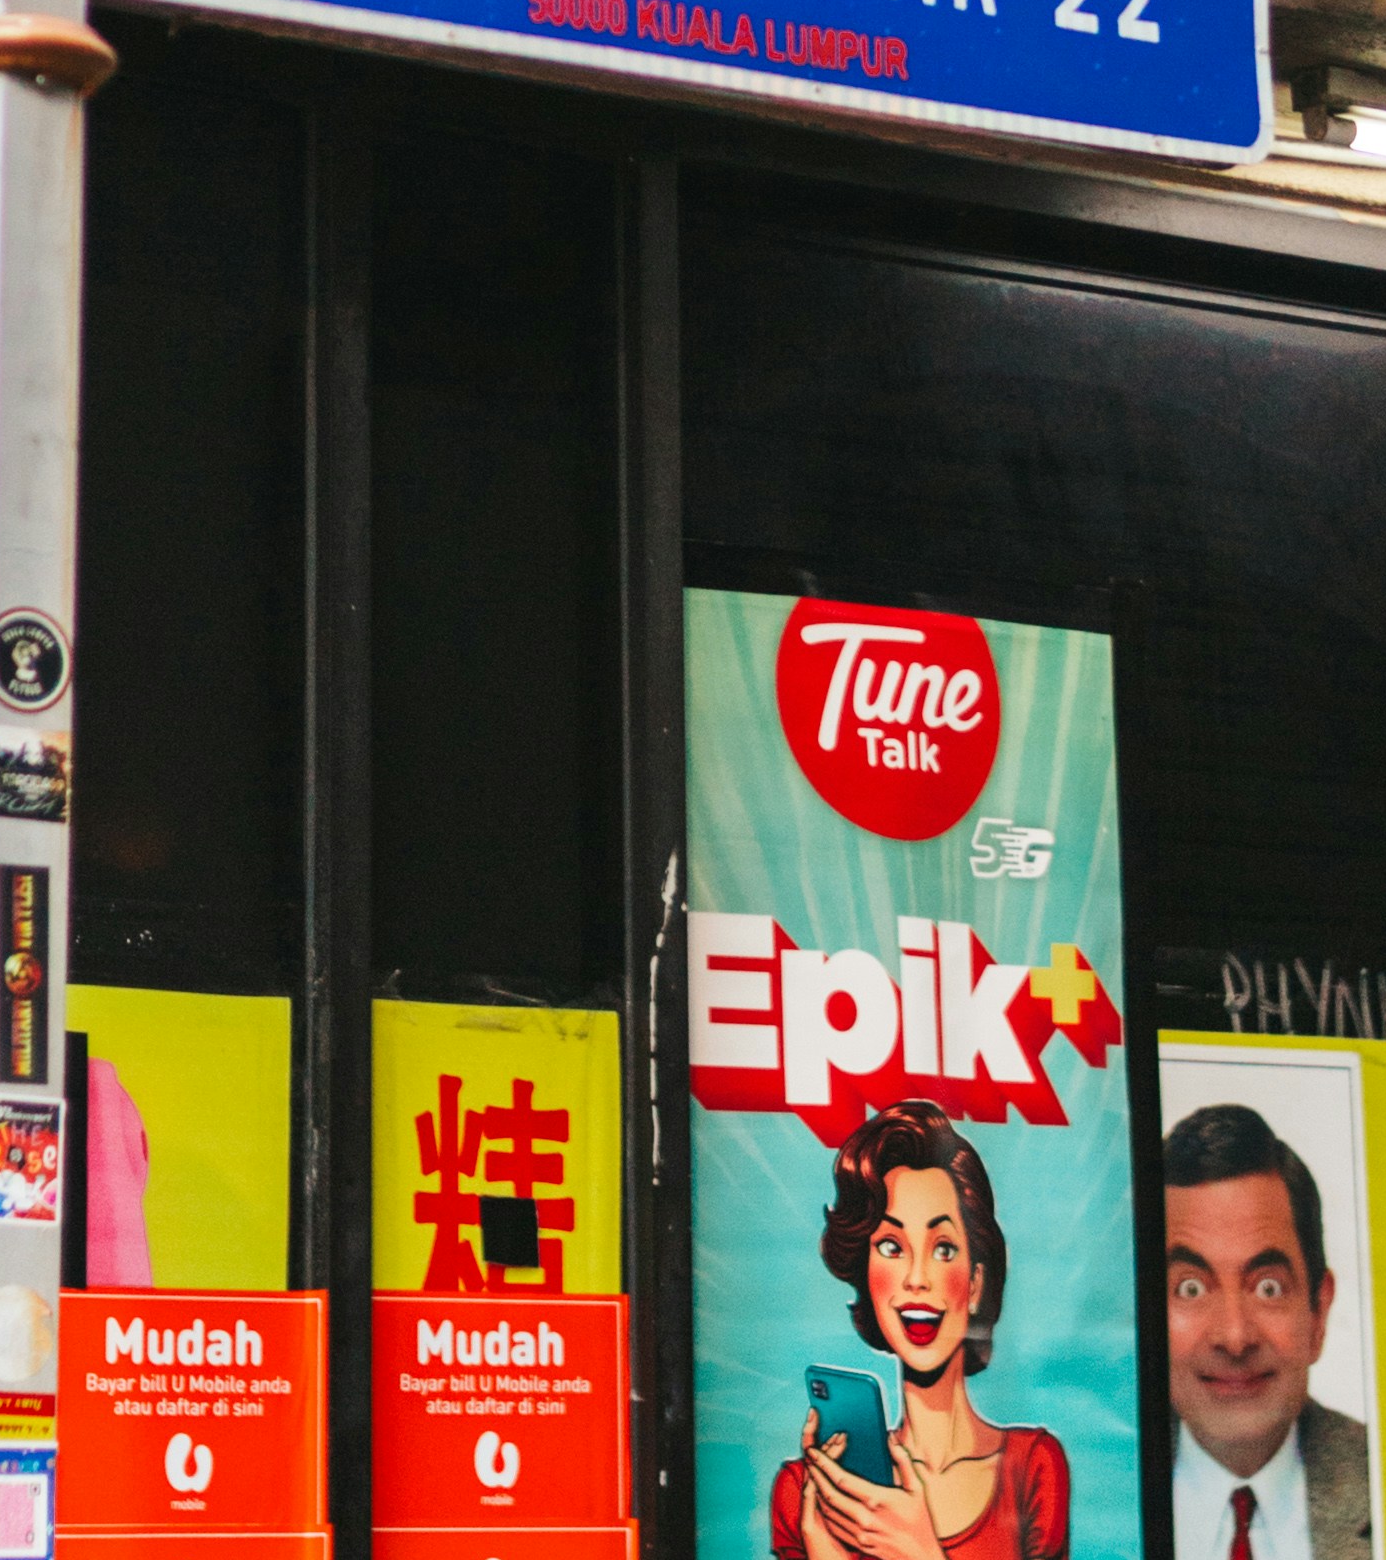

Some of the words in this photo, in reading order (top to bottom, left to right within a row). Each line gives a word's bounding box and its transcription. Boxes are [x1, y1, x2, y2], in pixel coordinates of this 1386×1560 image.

[765, 18, 909, 81] LUMPUR
[800, 622, 983, 751] Tune
[857, 727, 941, 774] Talk
[105, 1317, 262, 1367] Mudah
[416, 1318, 565, 1367] Mudah
[86, 1373, 136, 1396] Bayar
[140, 1374, 167, 1392] bill
[172, 1375, 184, 1392] U
[189, 1375, 246, 1394] Mobile
[250, 1377, 291, 1394] anda
[114, 1399, 152, 1415] atau
[156, 1398, 208, 1416] daftar
[213, 1399, 229, 1416] di
[233, 1399, 264, 1416] sini
[400, 1373, 446, 1396] Bayar
[450, 1375, 476, 1393] bill
[480, 1375, 491, 1392] U
[496, 1375, 548, 1393] Mobile
[552, 1377, 591, 1394] anda
[426, 1399, 462, 1414] atau
[465, 1396, 514, 1415] daftar
[518, 1397, 533, 1415] di
[536, 1398, 565, 1415] sini
